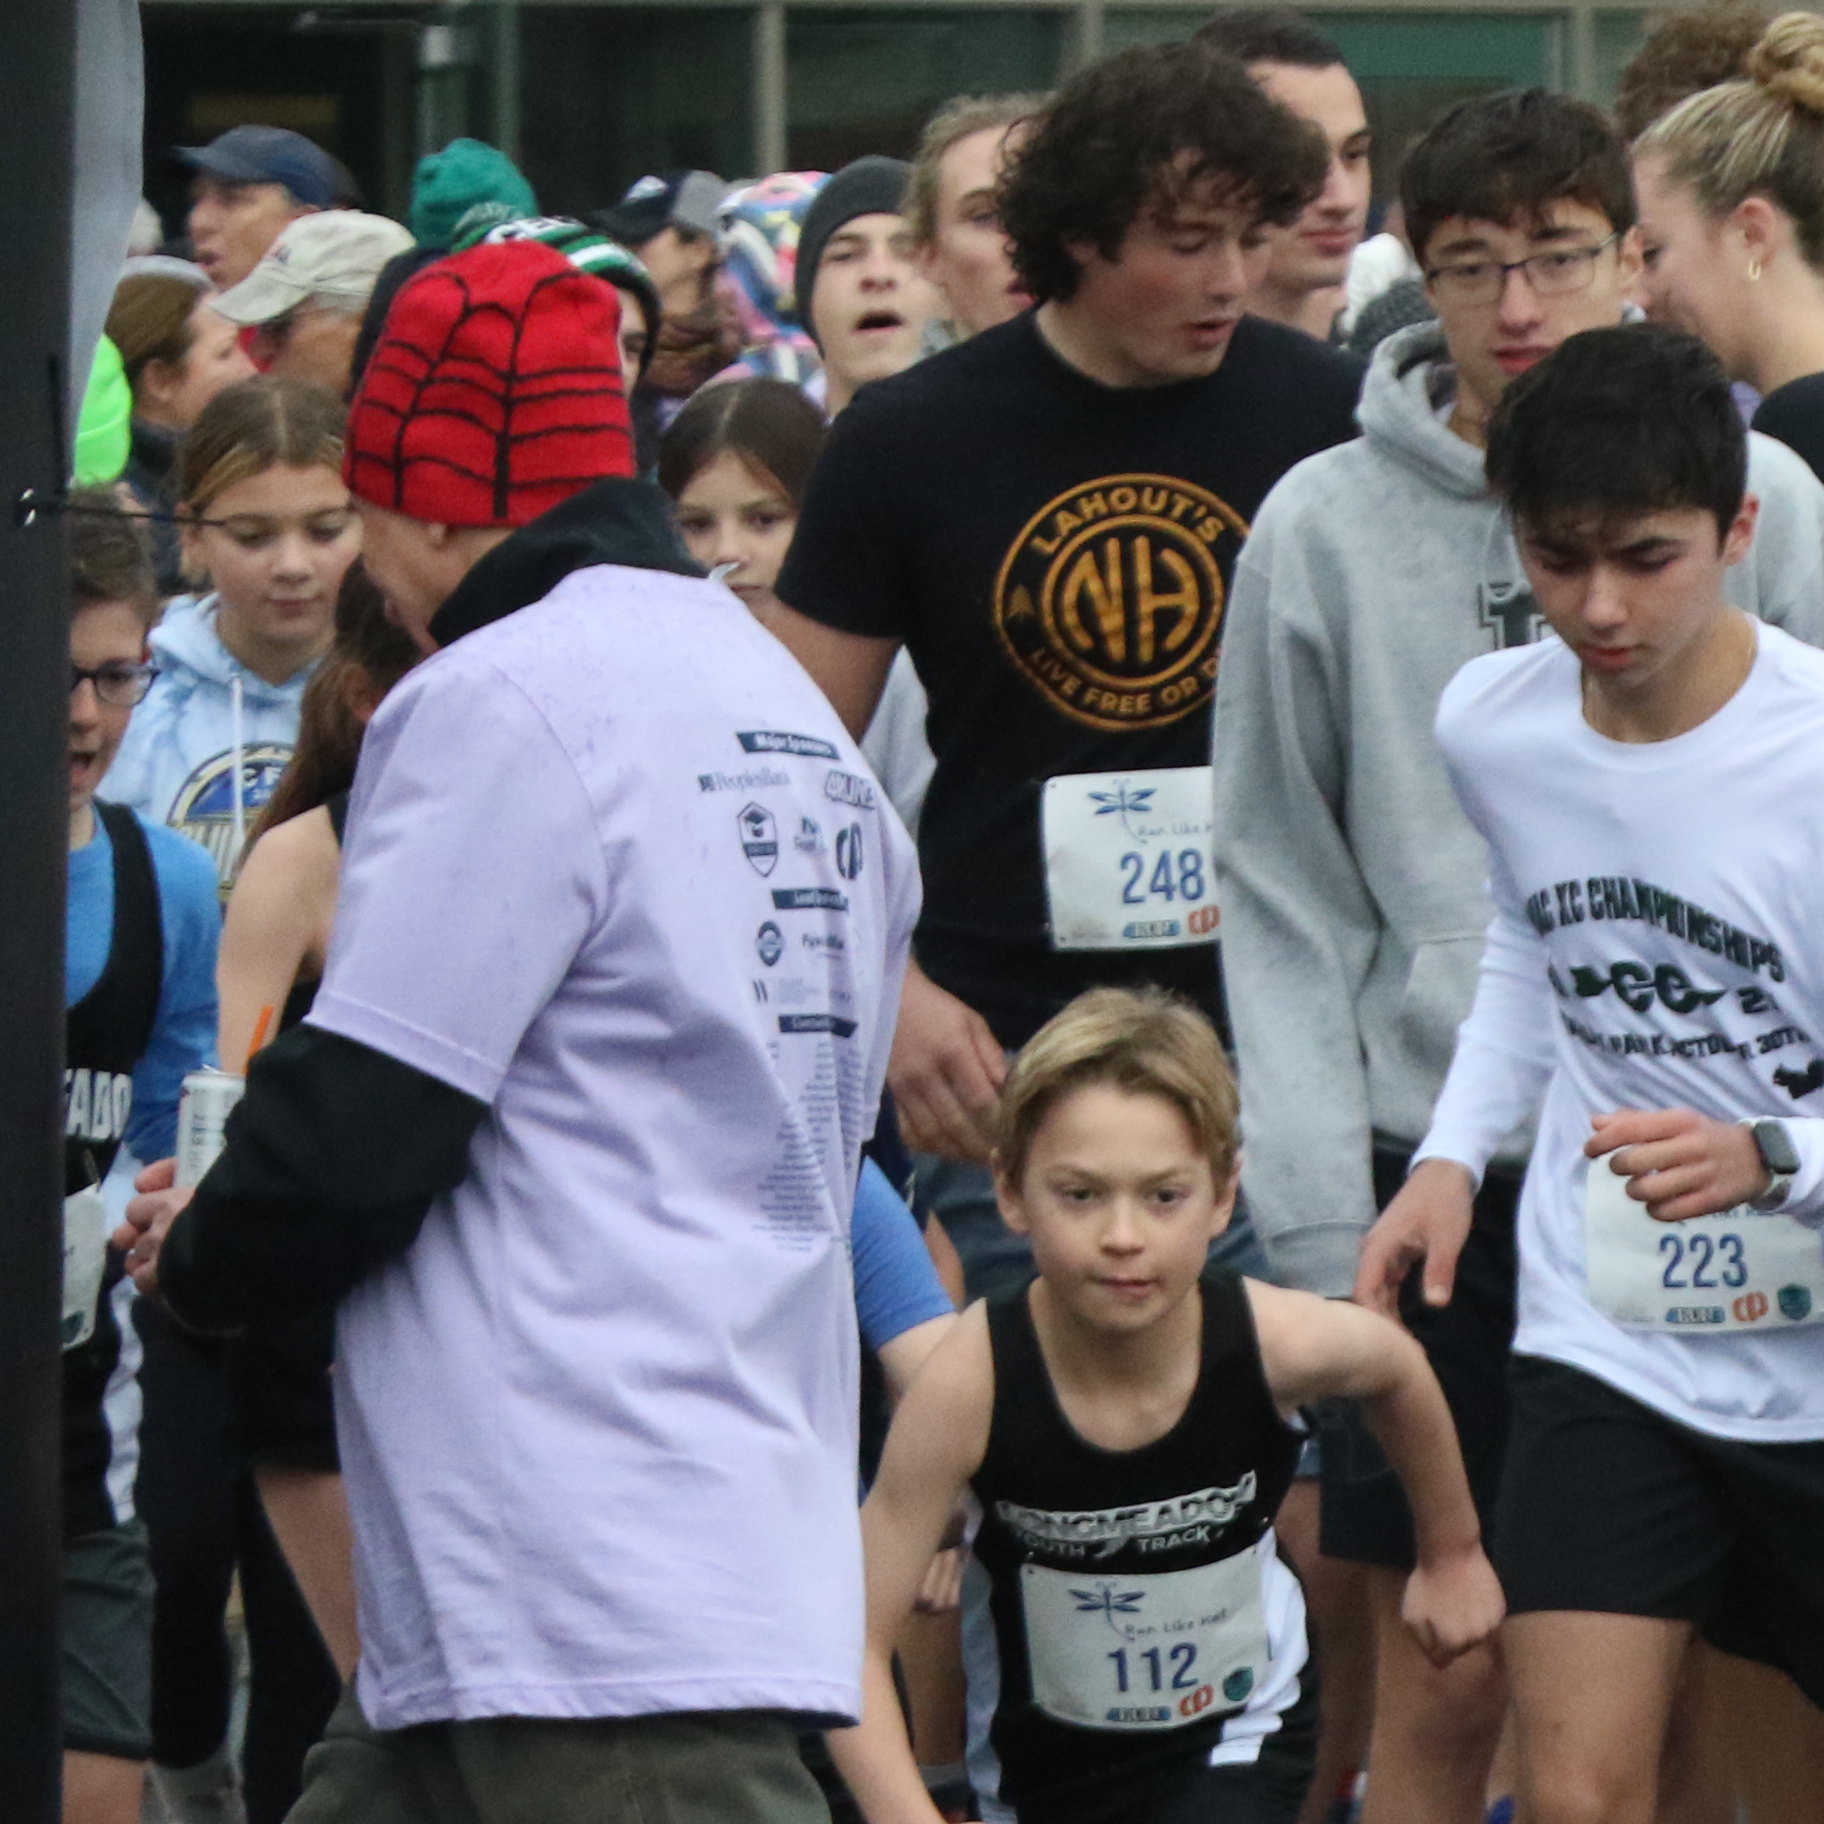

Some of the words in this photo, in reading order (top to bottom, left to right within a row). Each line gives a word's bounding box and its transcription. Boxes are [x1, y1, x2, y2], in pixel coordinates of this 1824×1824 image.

[1029, 485, 1226, 556] LAHOUT'S
[1062, 535, 1199, 663] NH
[1030, 647, 1083, 697] LIVE
[1083, 687, 1151, 714] FREE
[1160, 675, 1199, 705] OR
[1119, 848, 1206, 904] 248
[1555, 879, 1586, 927] XC
[1587, 876, 1785, 983] CHAMPIONSHIPS
[1659, 1233, 1748, 1288] 223
[1137, 1524, 1212, 1554] TRACK
[1124, 1622, 1158, 1637] Run
[1163, 1618, 1195, 1634] Like
[1199, 1607, 1228, 1628] Kat
[1107, 1642, 1198, 1693] 112
